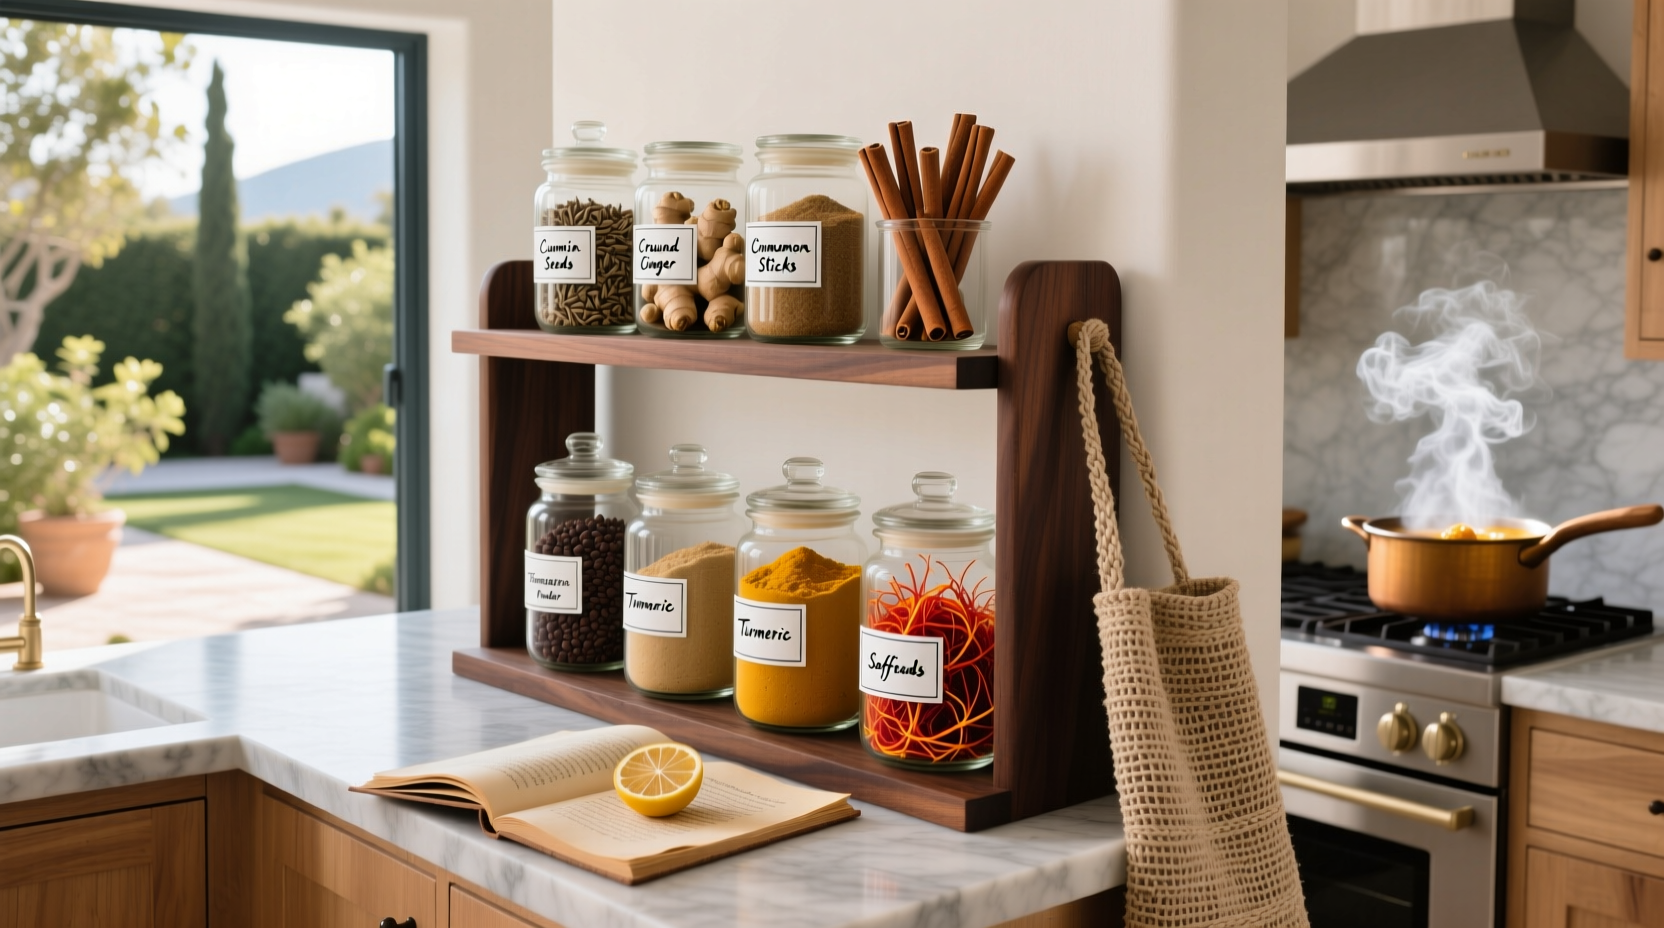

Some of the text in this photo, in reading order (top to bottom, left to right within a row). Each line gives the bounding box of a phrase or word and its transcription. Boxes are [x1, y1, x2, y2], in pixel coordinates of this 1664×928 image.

[545, 256, 573, 271] Seeds
[759, 256, 797, 273] Sticks
[738, 618, 792, 641] Turmeric
